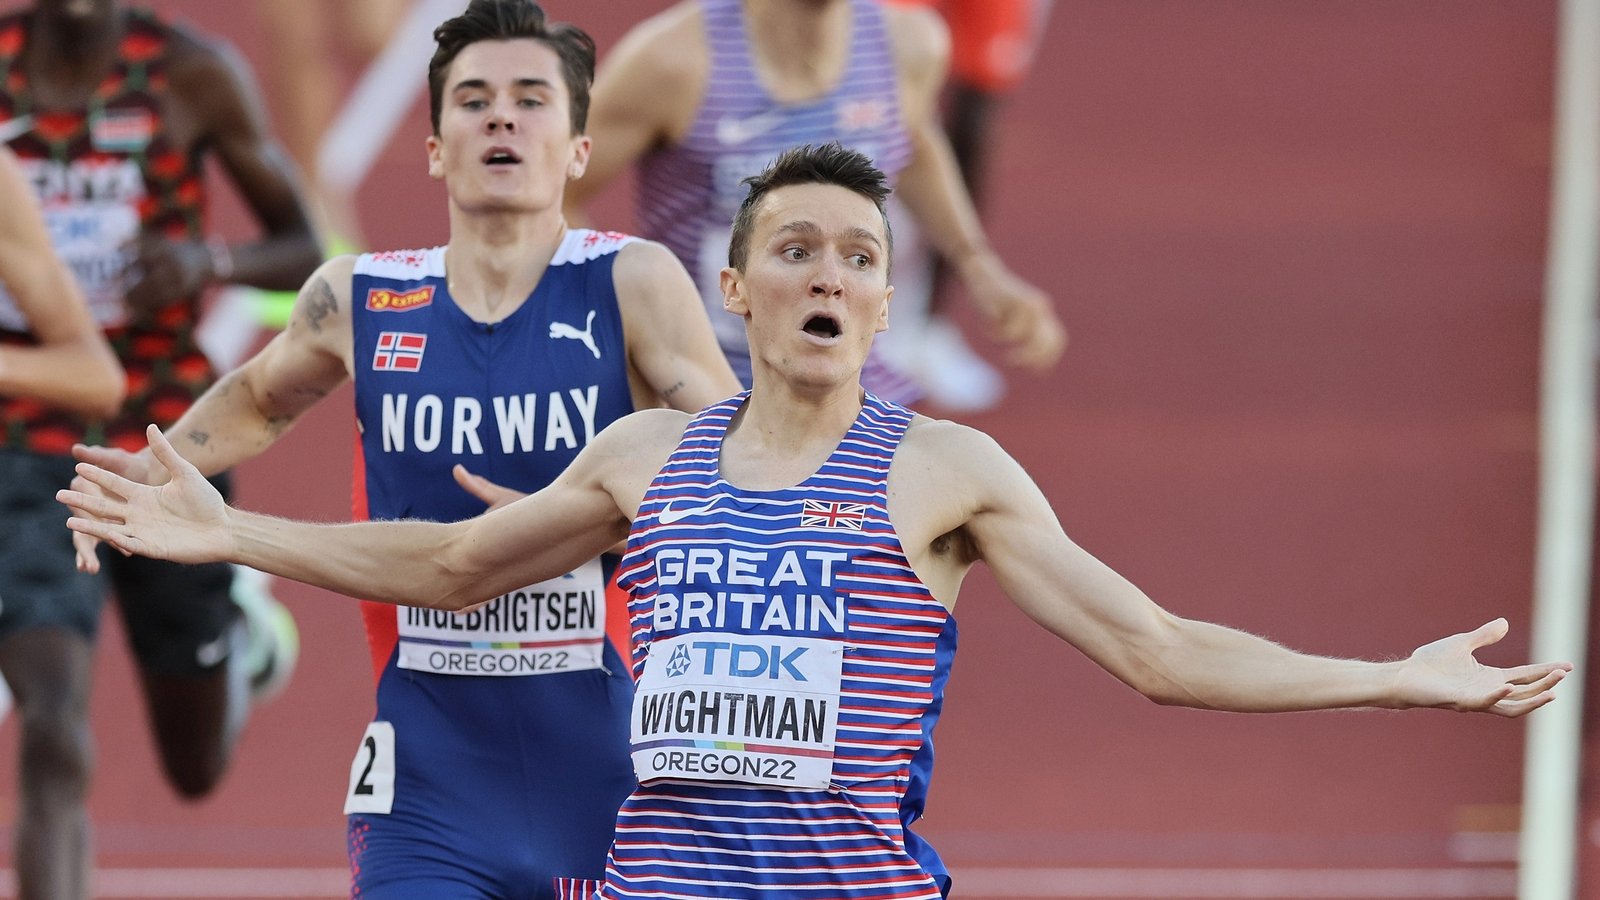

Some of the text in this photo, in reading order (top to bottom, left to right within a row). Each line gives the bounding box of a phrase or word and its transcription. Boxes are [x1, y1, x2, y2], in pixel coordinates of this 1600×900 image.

[382, 385, 599, 455] NORWAY
[655, 548, 848, 587] GREAT
[653, 592, 845, 633] BRITAIN
[429, 651, 569, 672] OREGON22
[692, 641, 810, 681] TDK
[641, 690, 826, 743] WIGHTMAN
[354, 736, 376, 795] 2
[652, 751, 797, 780] OREGON22
